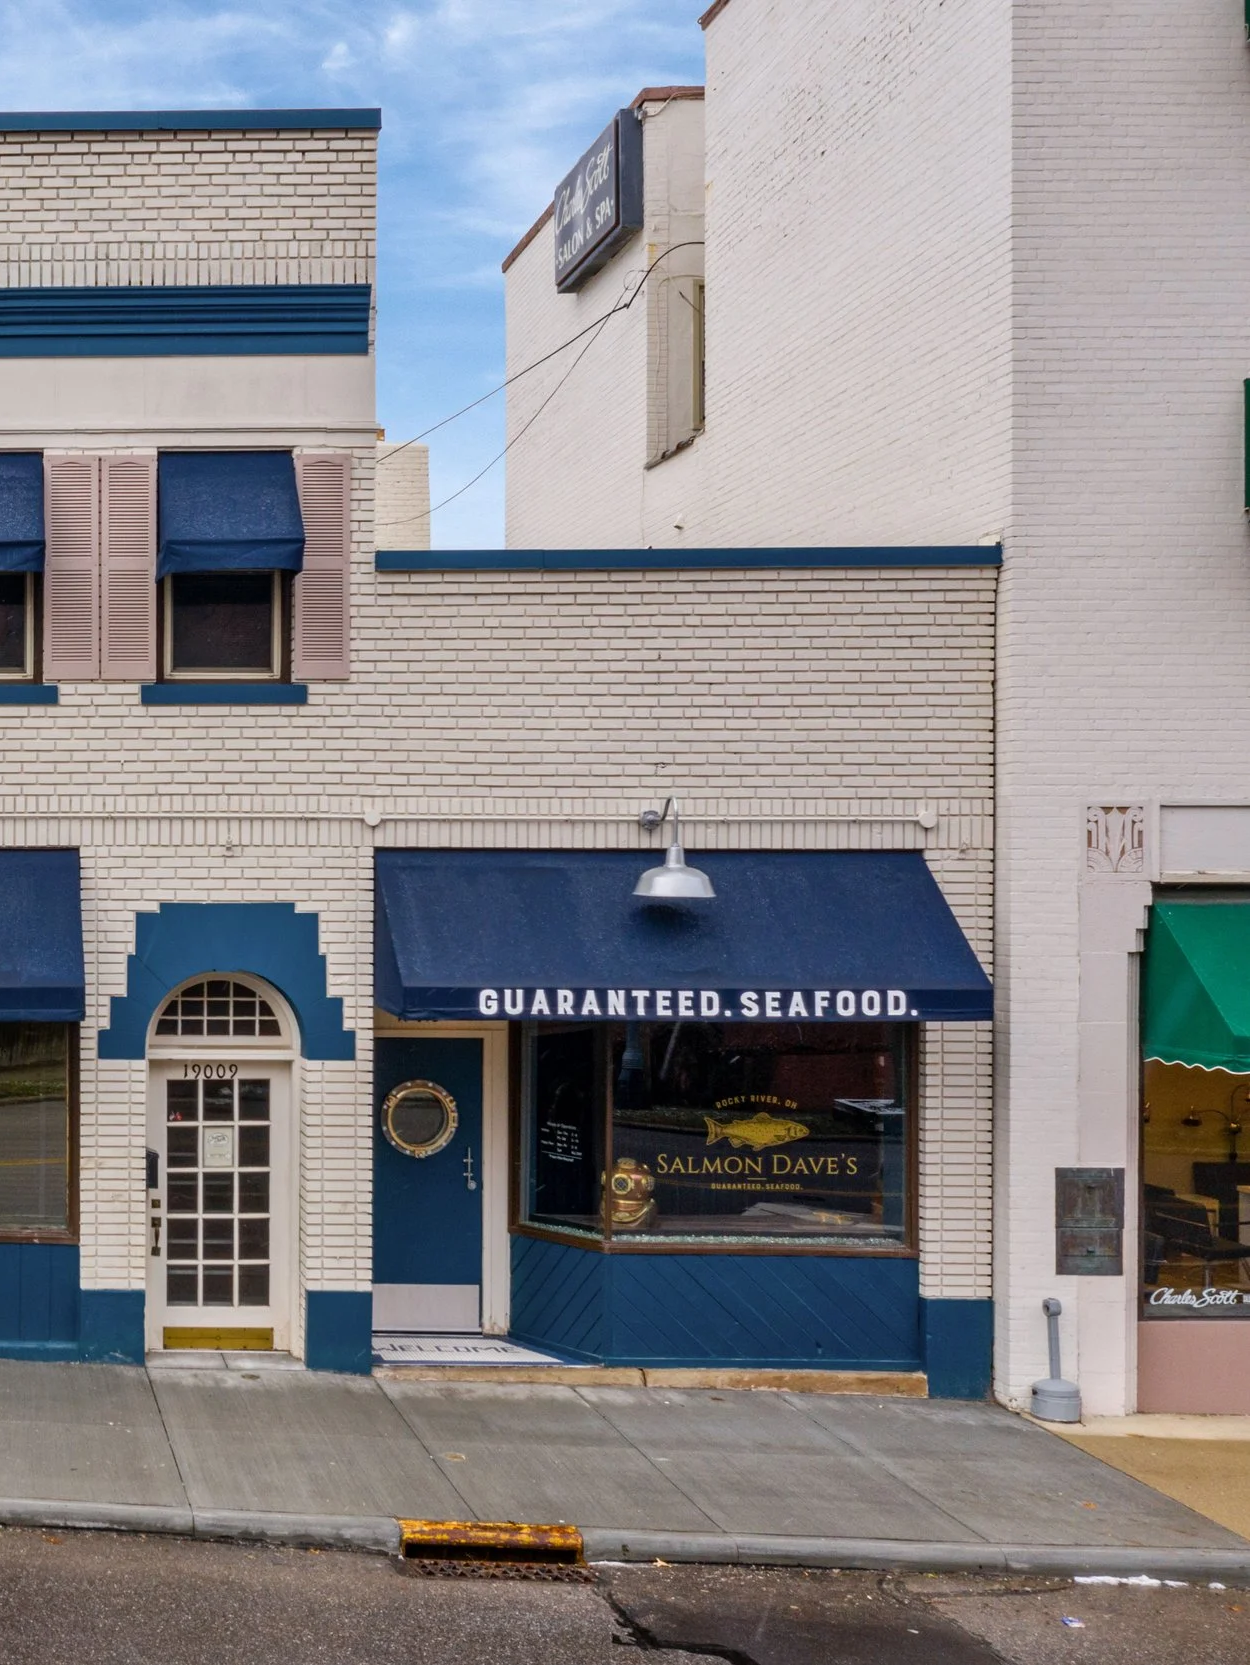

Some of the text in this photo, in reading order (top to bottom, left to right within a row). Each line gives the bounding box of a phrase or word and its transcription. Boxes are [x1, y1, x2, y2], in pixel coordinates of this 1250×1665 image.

[558, 196, 611, 270] SALON & SPA
[184, 1063, 238, 1079] 19009
[715, 1095, 746, 1109] ROCKY
[784, 1099, 798, 1109] OH
[657, 1153, 858, 1175] SALMON DAVE'S
[1149, 1287, 1197, 1305] Charles
[1193, 1288, 1243, 1308] Scott
